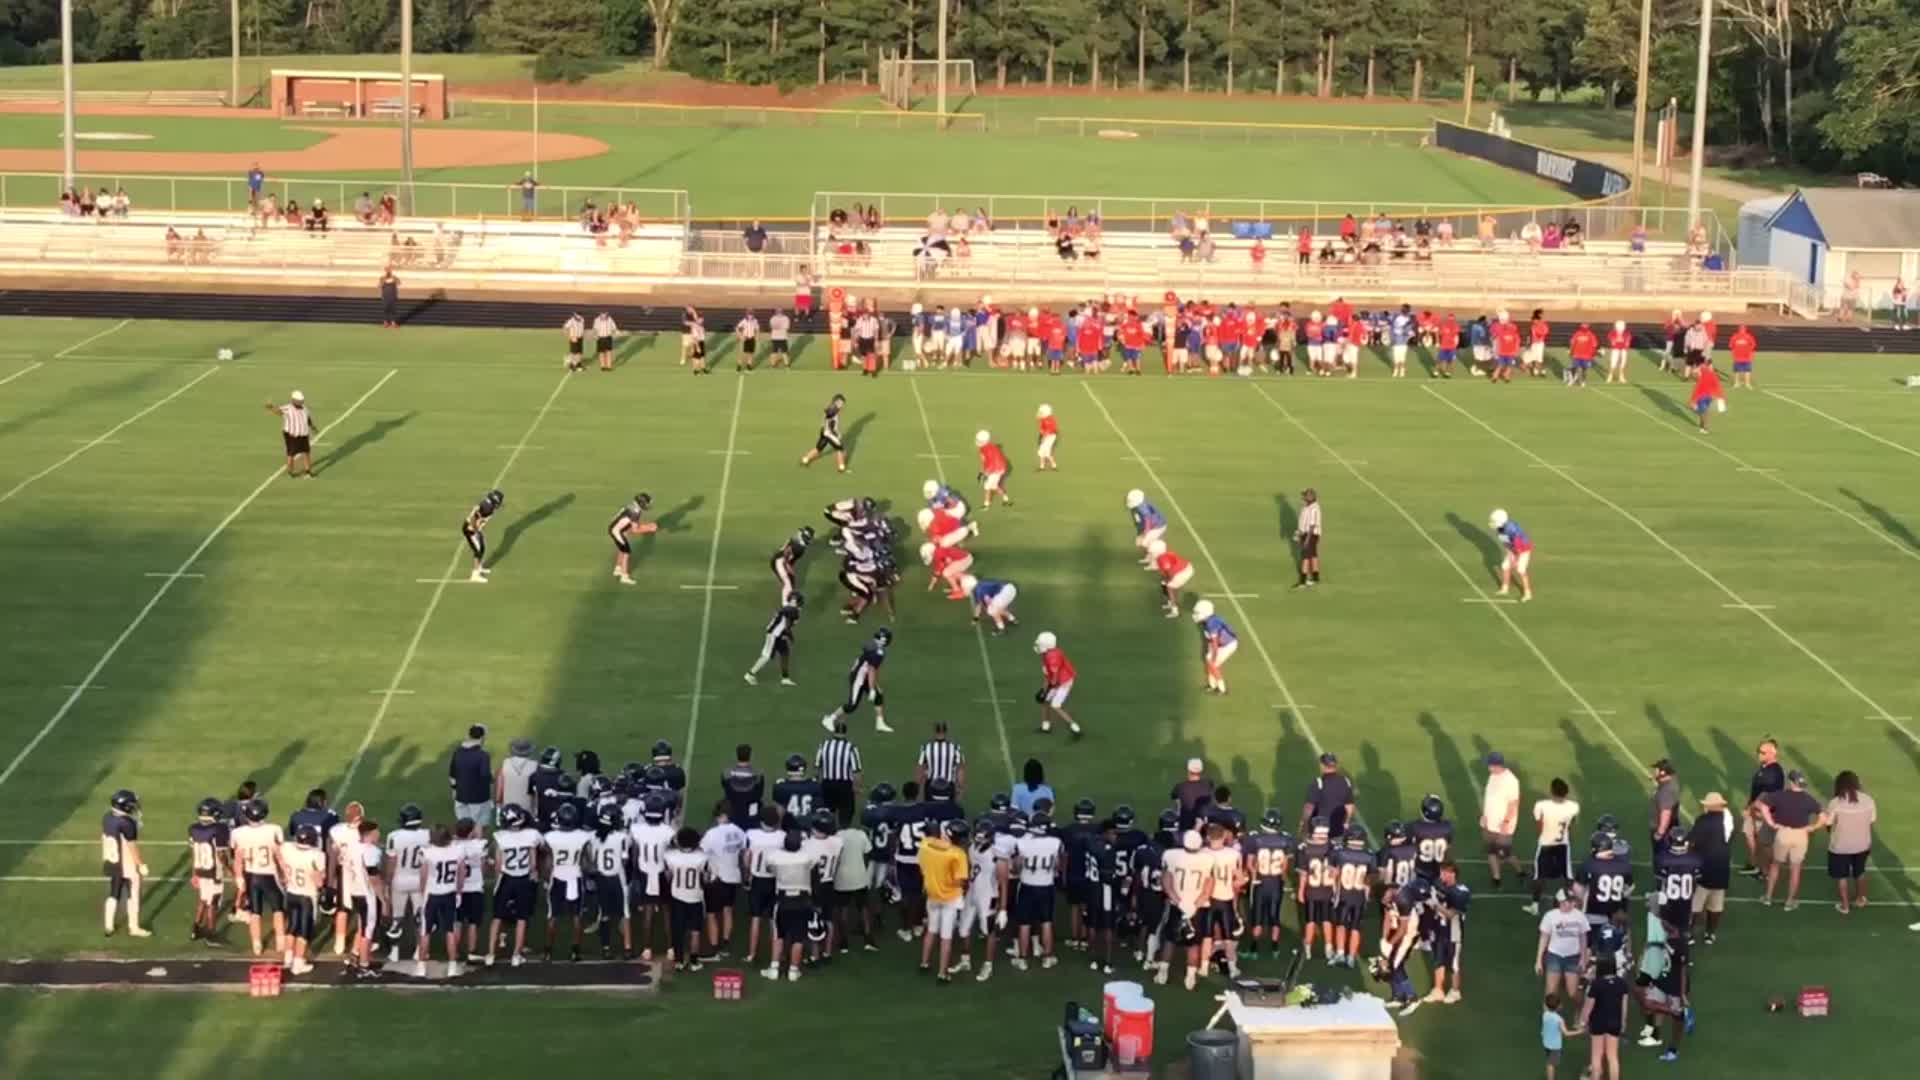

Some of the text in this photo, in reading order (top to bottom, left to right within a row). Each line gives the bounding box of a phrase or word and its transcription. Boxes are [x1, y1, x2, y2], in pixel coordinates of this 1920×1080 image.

[504, 847, 530, 870] 22
[1419, 838, 1447, 862] 90
[1024, 854, 1054, 872] 44
[676, 867, 697, 889] 10
[1175, 867, 1203, 891] 77
[1596, 874, 1625, 902] 99
[1667, 873, 1693, 901] 60
